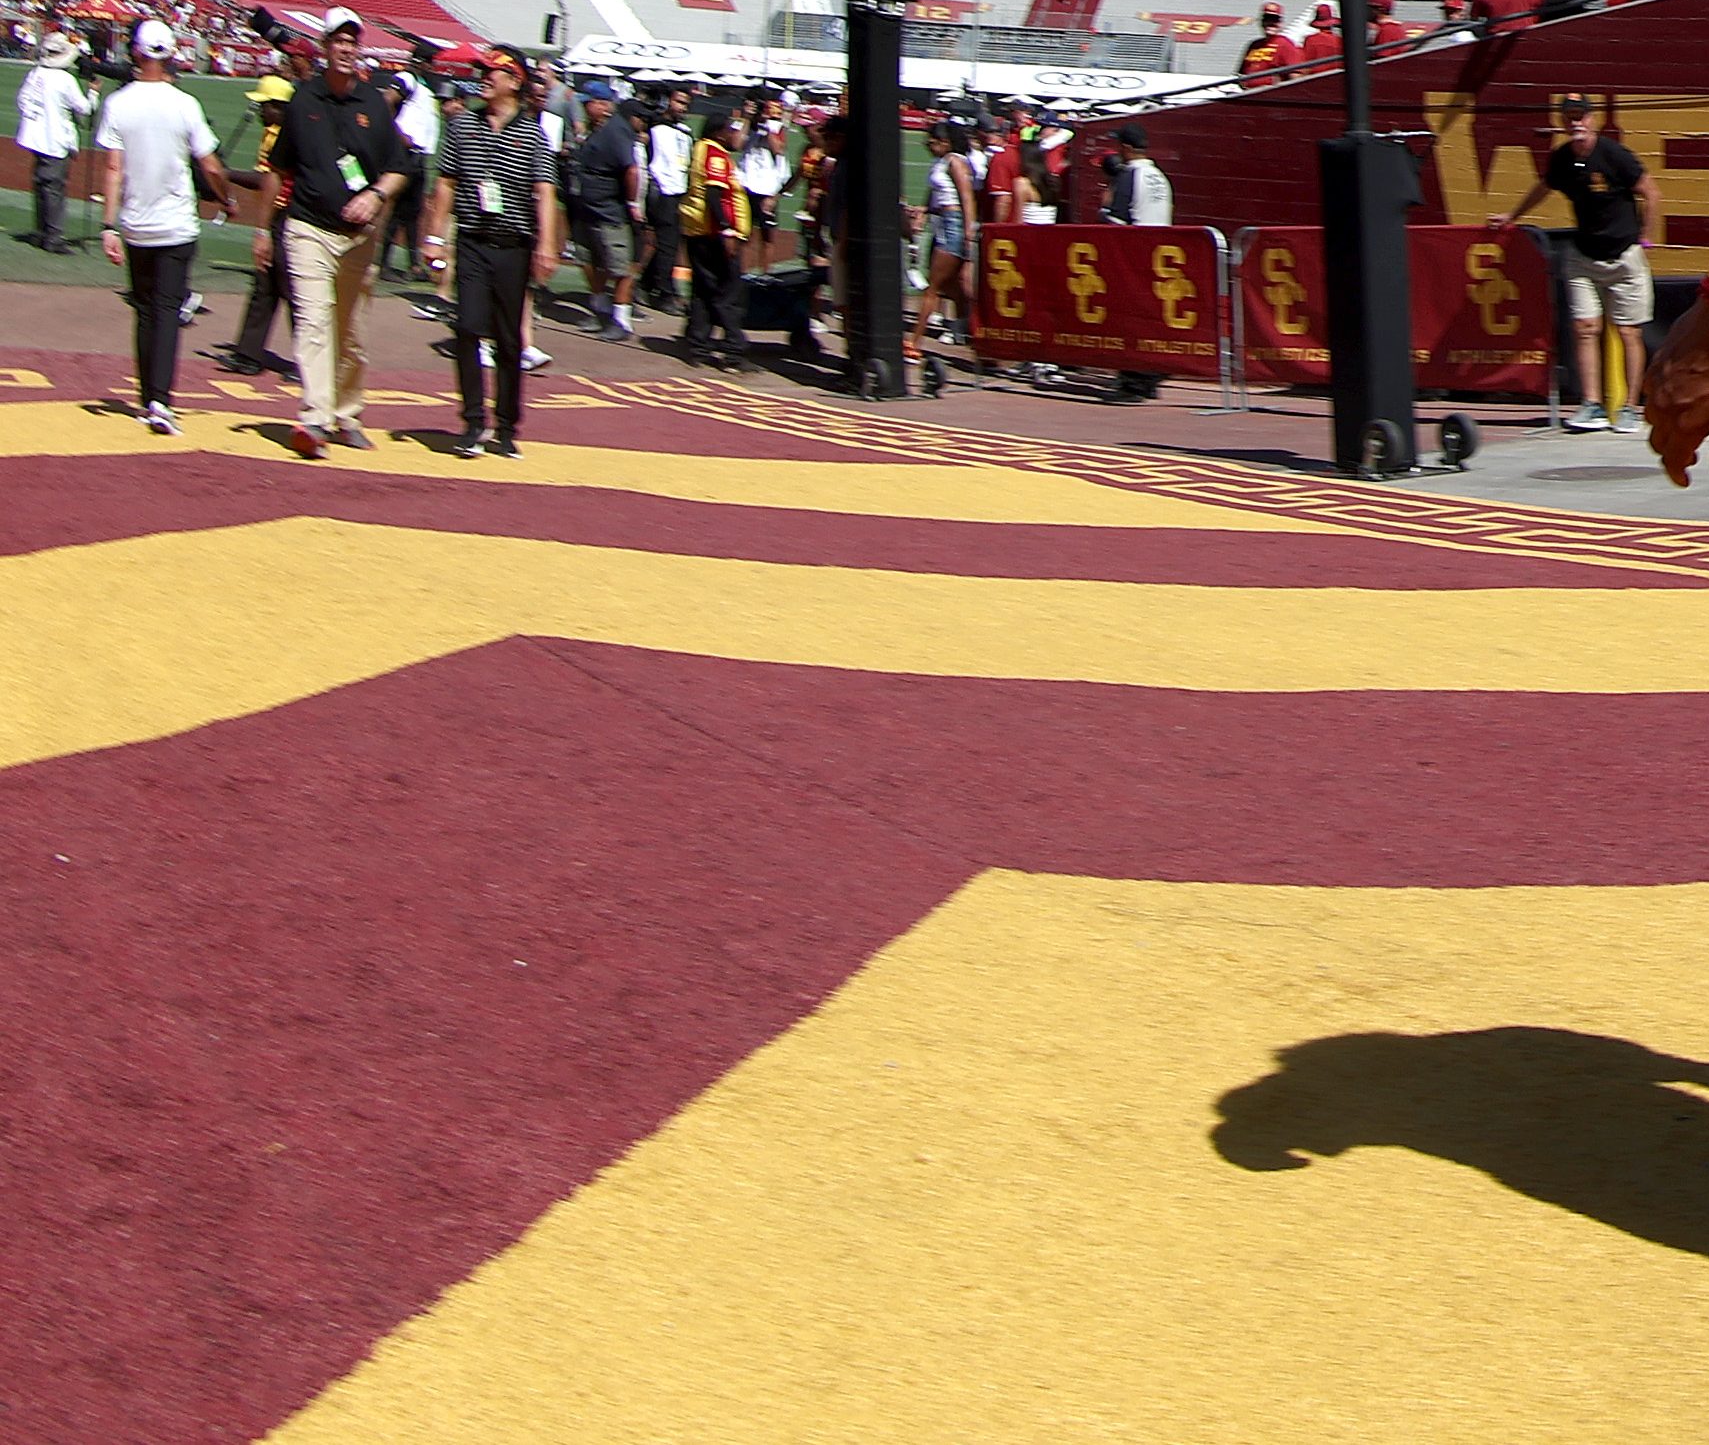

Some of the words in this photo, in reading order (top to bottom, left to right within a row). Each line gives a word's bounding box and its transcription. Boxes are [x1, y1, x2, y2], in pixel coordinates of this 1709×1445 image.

[914, 2, 951, 19] 12
[987, 239, 1025, 318] SC
[1067, 242, 1107, 324] SC
[1152, 245, 1197, 329] SC
[1262, 248, 1310, 335] SC
[1464, 243, 1520, 335] SC
[1053, 334, 1126, 350] ATHLETICS
[1136, 339, 1217, 355] ATHLETICS
